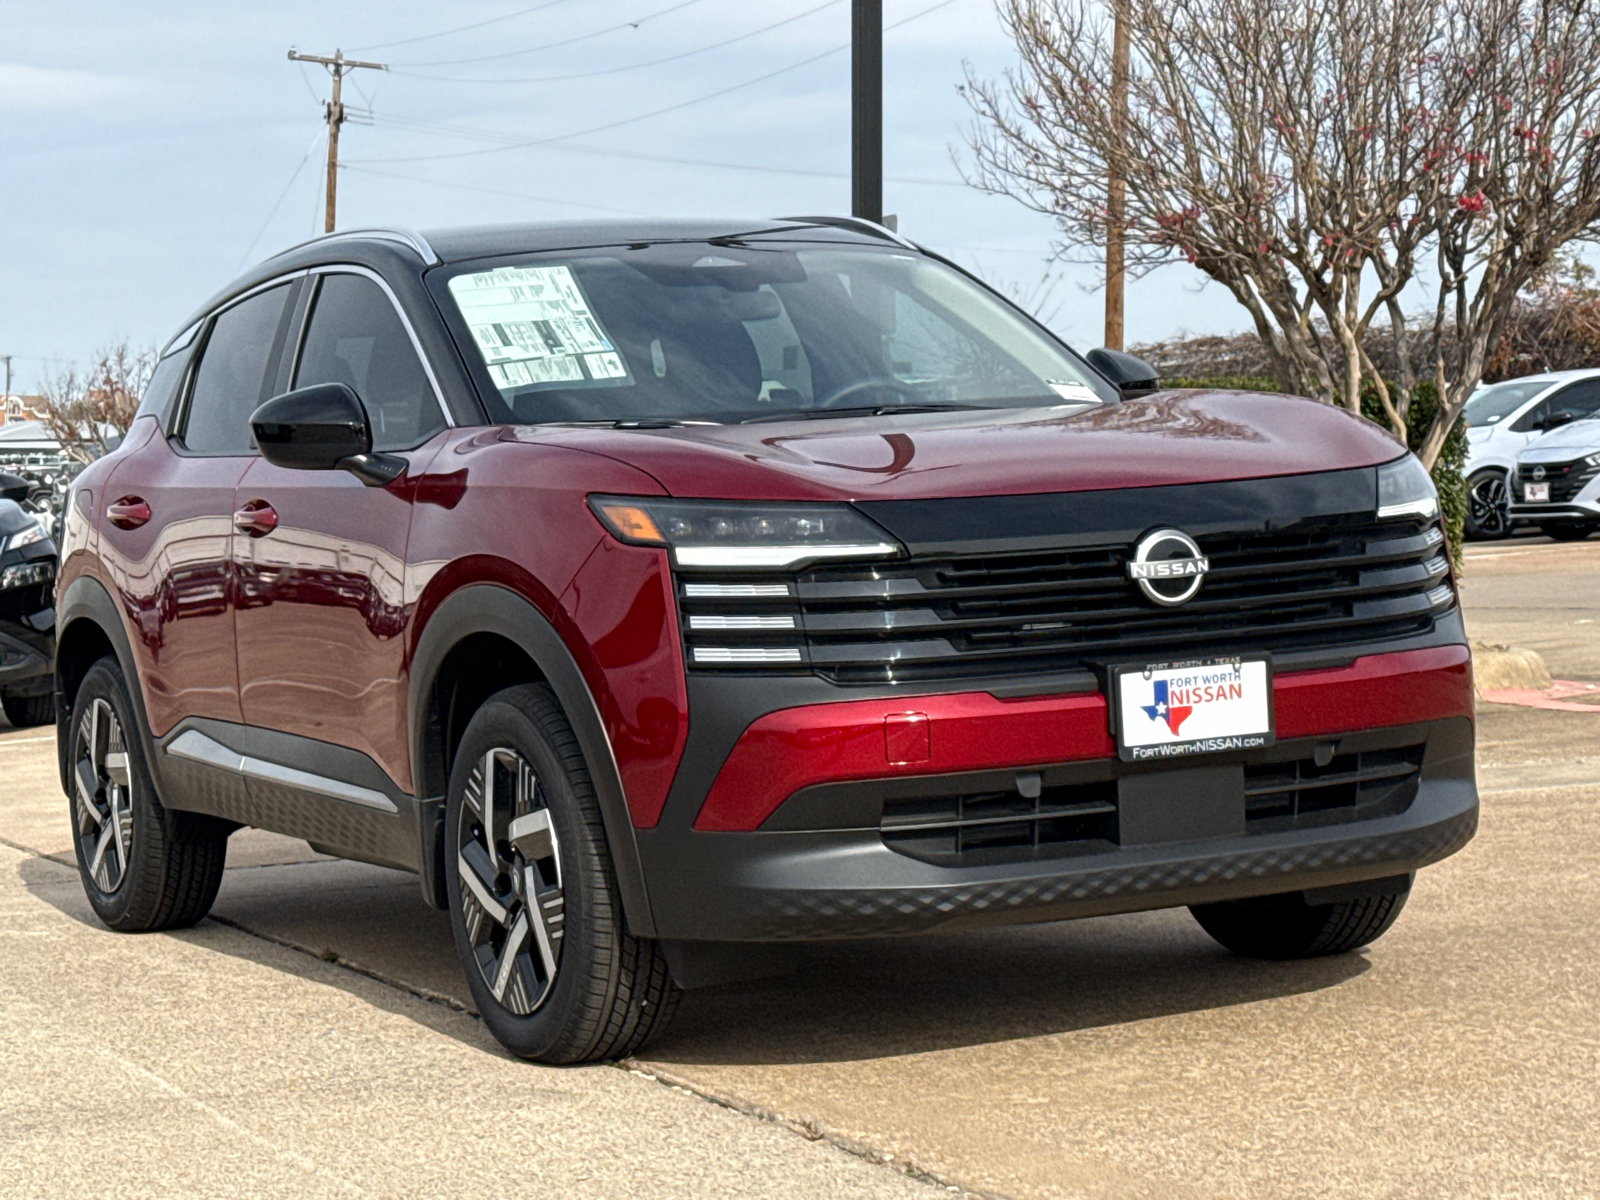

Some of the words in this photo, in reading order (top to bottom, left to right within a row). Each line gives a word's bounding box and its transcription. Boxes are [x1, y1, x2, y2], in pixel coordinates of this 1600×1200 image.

[1133, 559, 1209, 577] NISSAN
[1146, 662, 1169, 671] FORT
[1172, 660, 1202, 669] WORTH
[1214, 656, 1241, 665] TEXAS
[1169, 676, 1199, 688] FORT
[1201, 672, 1241, 685] WORTH
[1170, 683, 1242, 706] NISSAN
